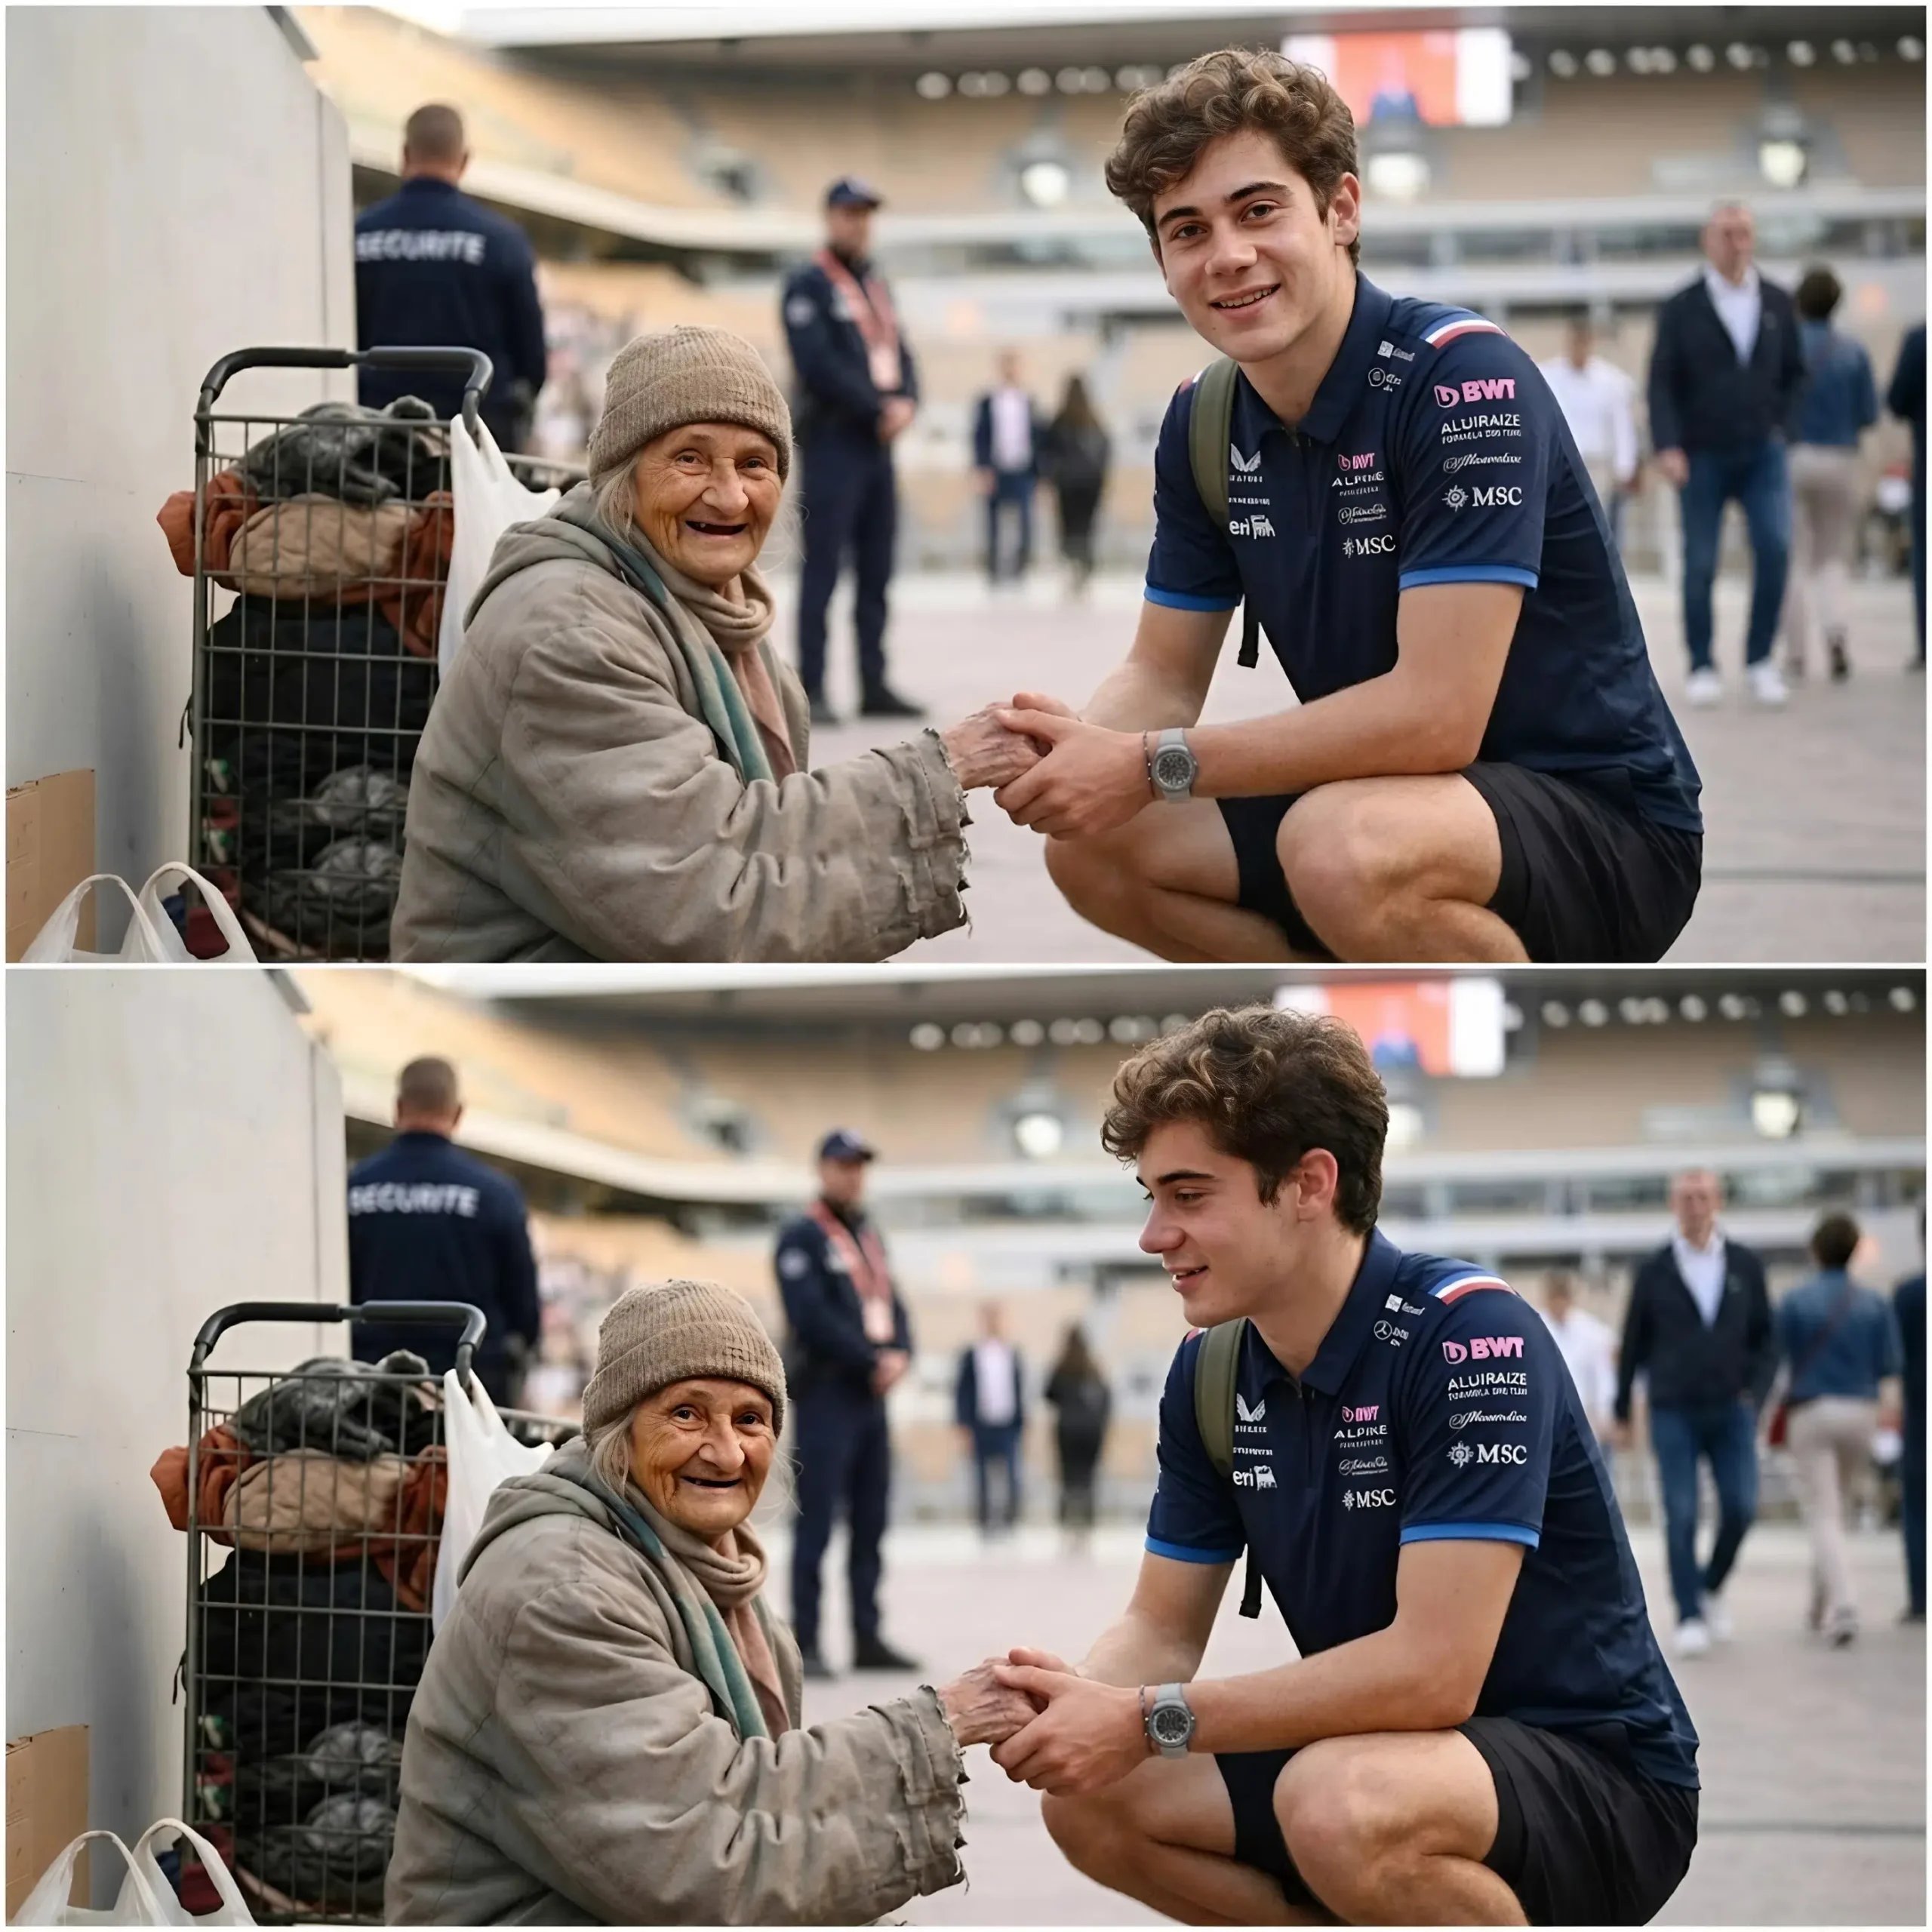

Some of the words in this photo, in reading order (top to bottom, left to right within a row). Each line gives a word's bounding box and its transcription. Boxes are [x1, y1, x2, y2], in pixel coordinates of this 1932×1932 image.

[1461, 379, 1515, 403] BWT
[1472, 487, 1522, 506] MSC
[1355, 534, 1395, 555] MSC
[1469, 1337, 1524, 1359] BWT
[1476, 1444, 1527, 1464] MSC
[1356, 1489, 1396, 1508] MSC
